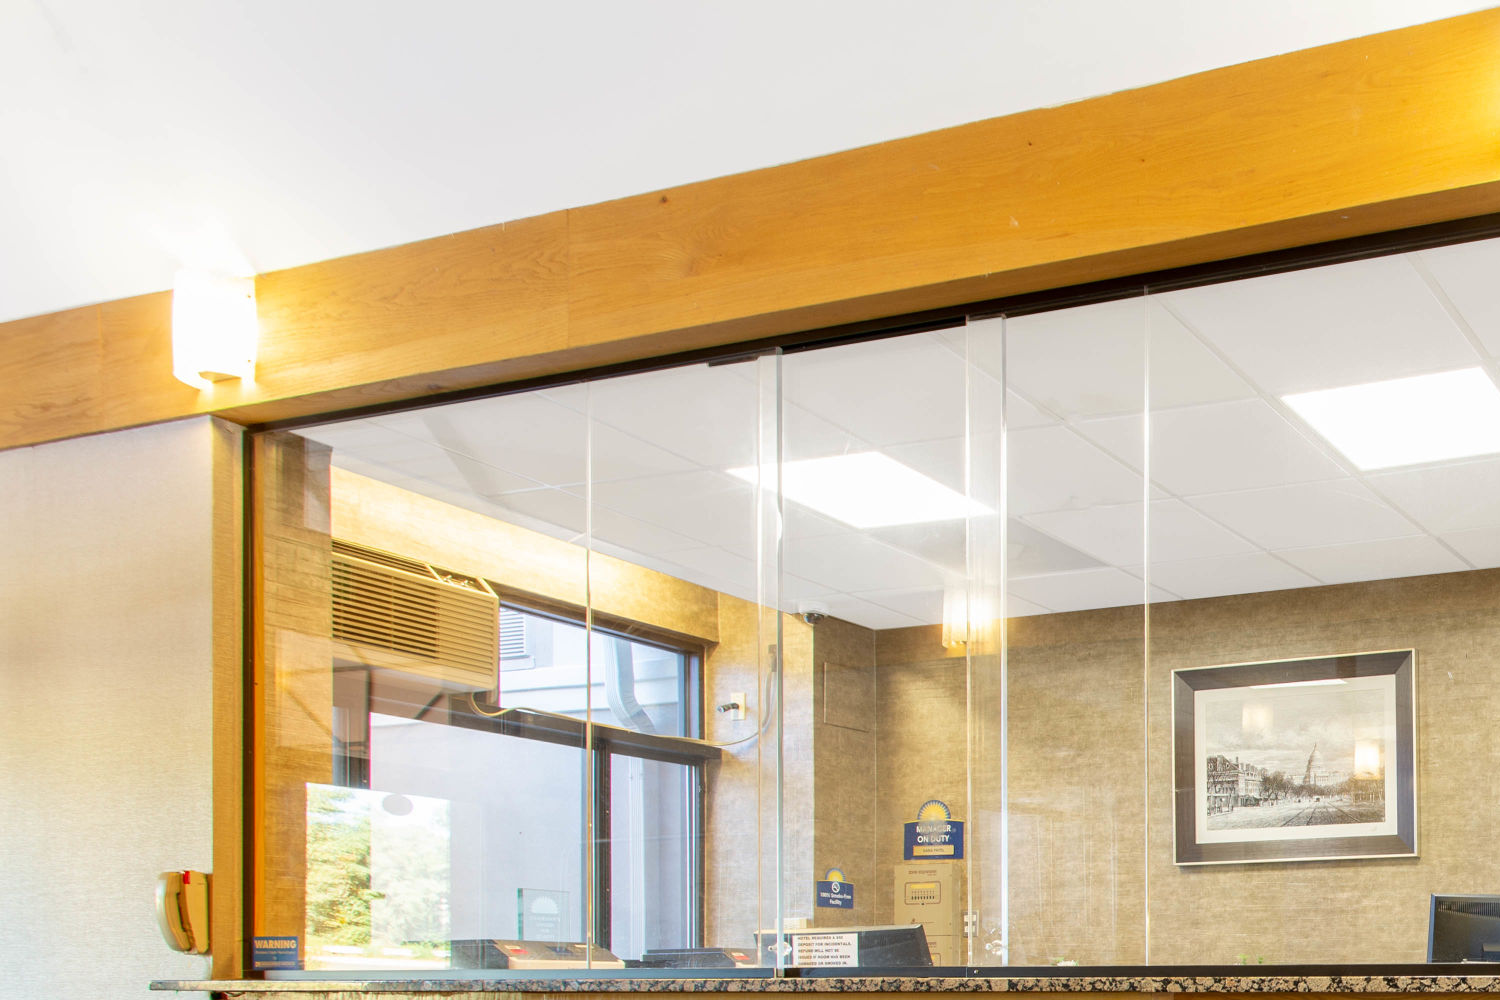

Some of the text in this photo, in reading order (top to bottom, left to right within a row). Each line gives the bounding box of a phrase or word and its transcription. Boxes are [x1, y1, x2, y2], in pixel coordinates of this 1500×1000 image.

[916, 824, 952, 833] MANAGER
[917, 834, 950, 843] ON DUTY
[254, 939, 297, 949] WARNING
